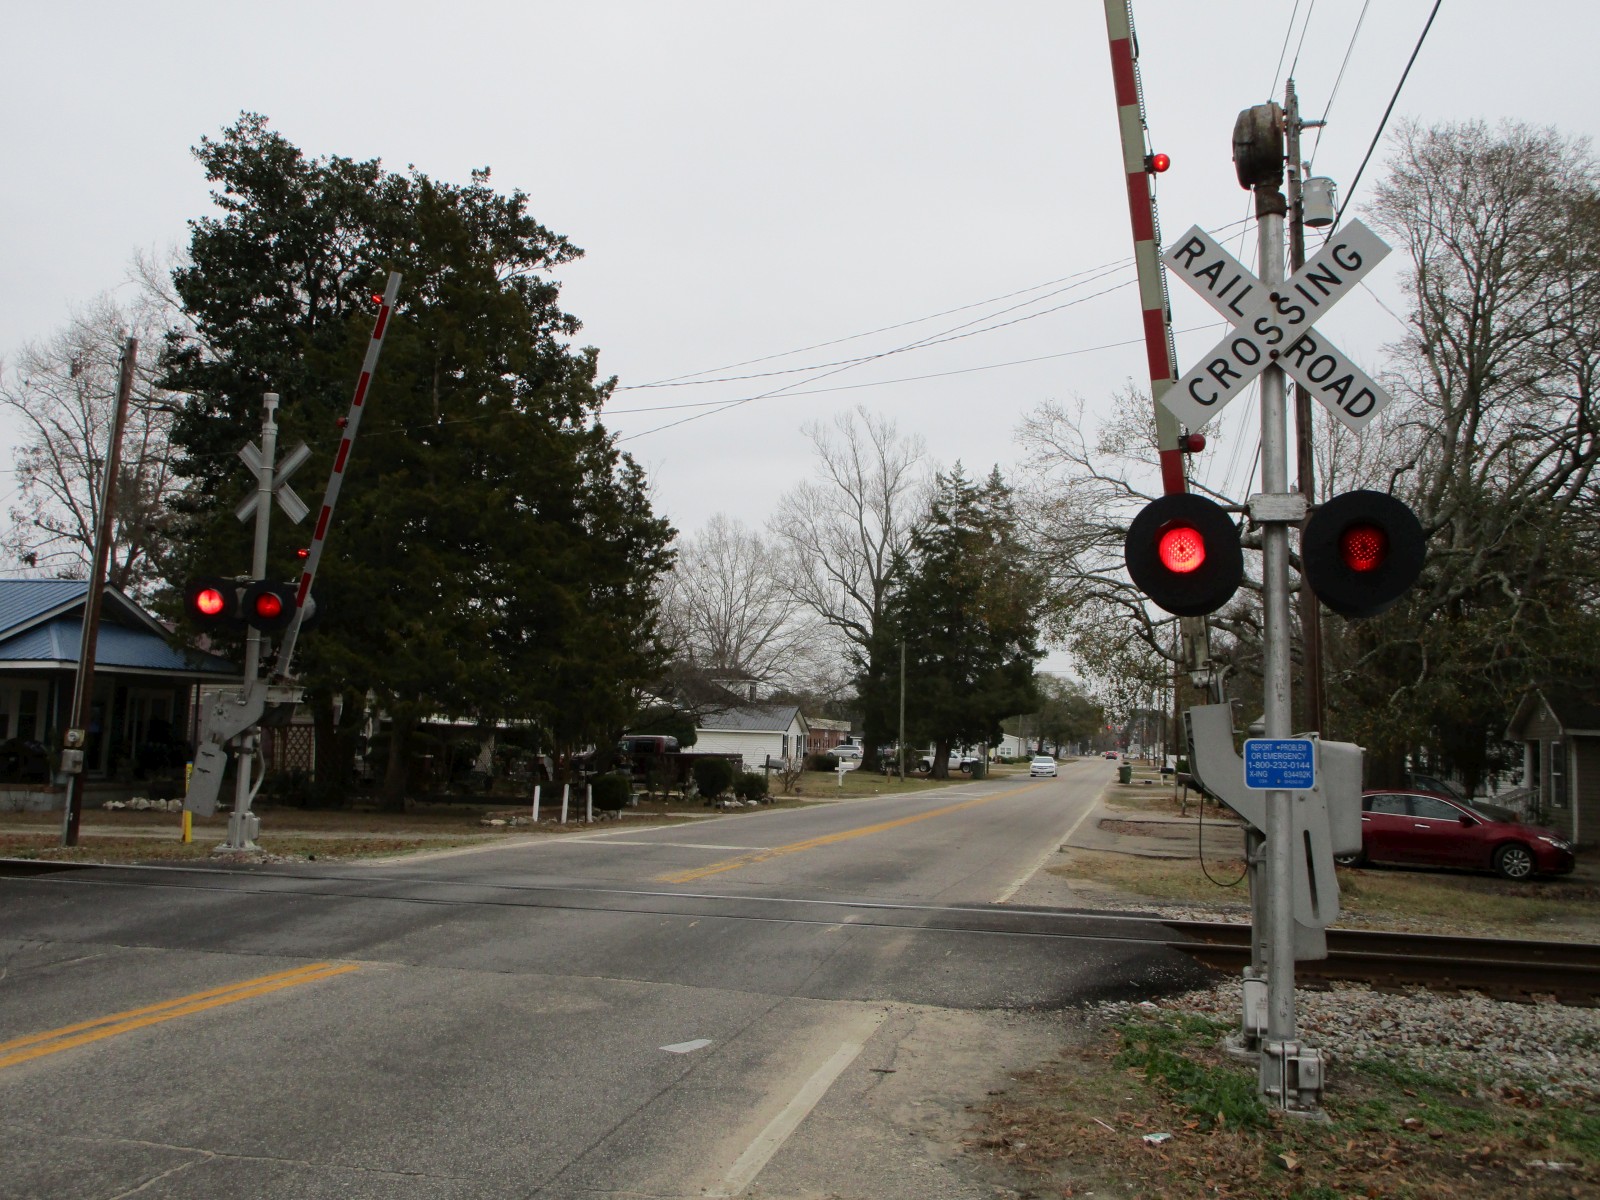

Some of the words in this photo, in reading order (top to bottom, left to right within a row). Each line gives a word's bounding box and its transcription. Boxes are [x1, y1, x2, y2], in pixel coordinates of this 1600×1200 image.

[1173, 236, 1253, 317] RAIL
[1284, 333, 1376, 418] ROAD
[1188, 243, 1363, 407] CROSSING
[1248, 761, 1310, 769] 1-800-232-0144
[1249, 770, 1268, 778] X-ING
